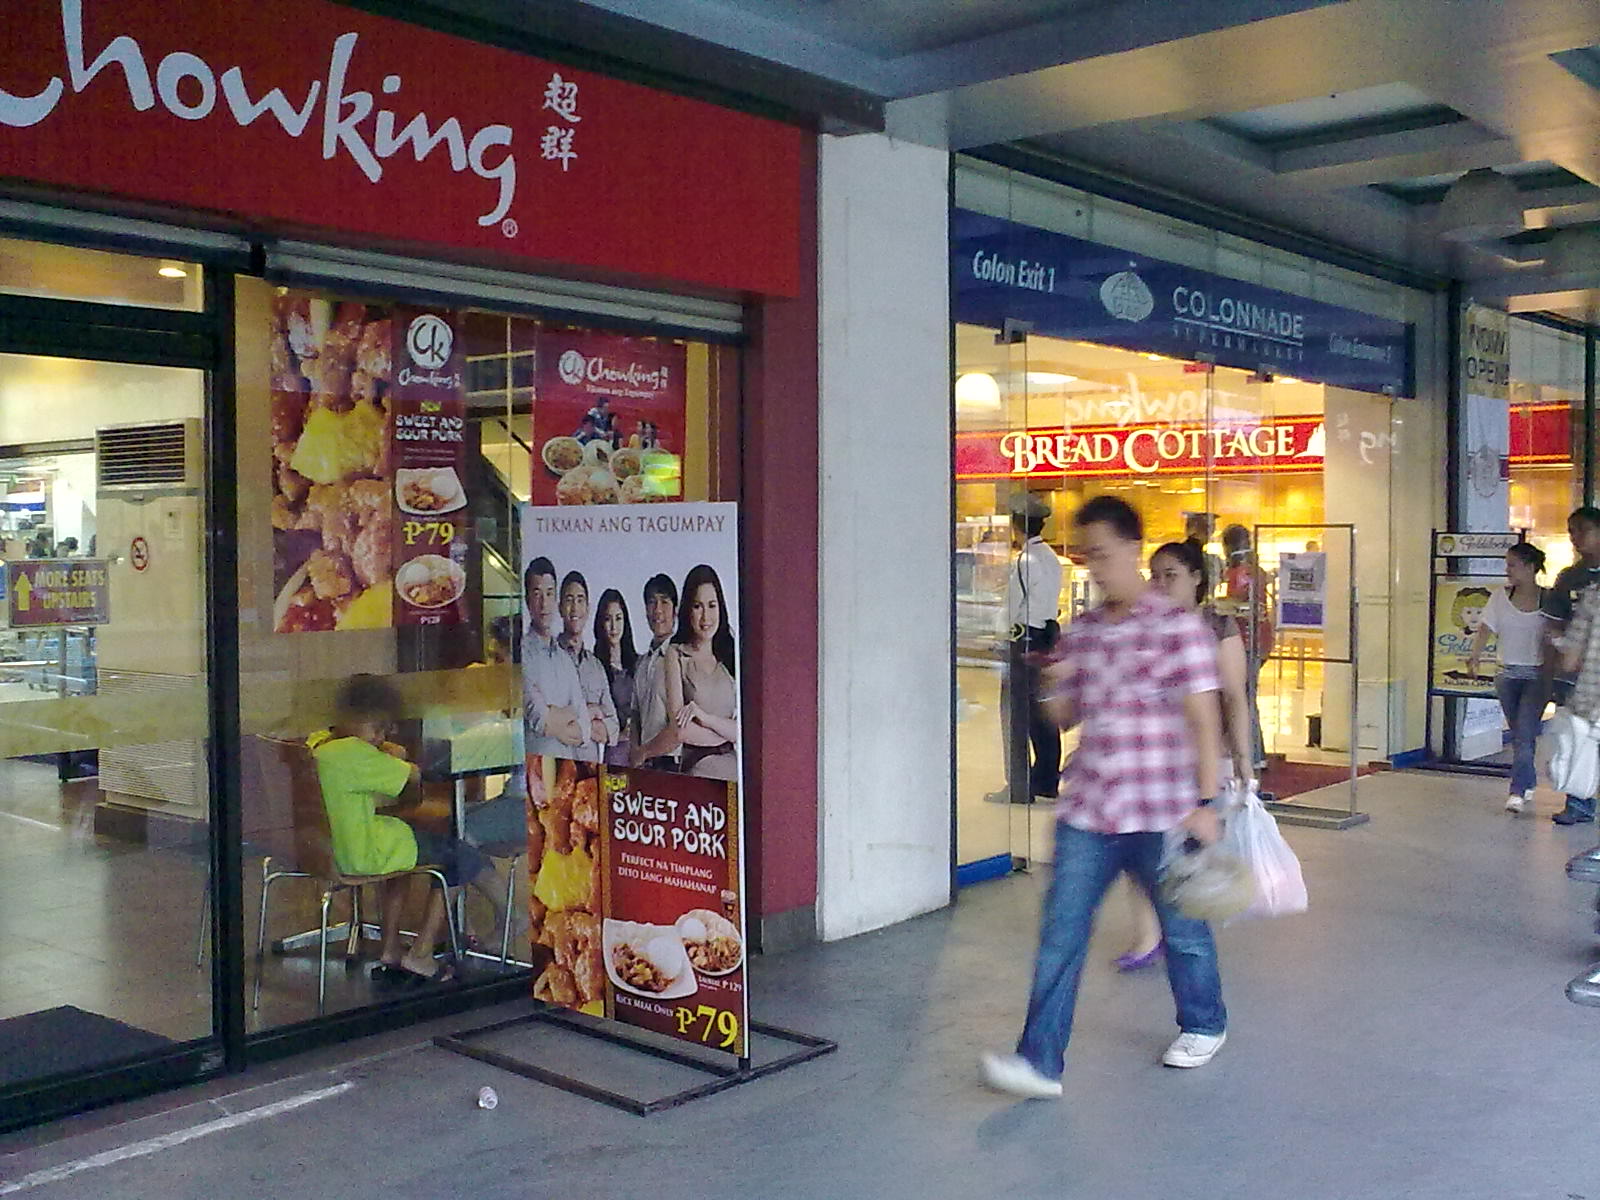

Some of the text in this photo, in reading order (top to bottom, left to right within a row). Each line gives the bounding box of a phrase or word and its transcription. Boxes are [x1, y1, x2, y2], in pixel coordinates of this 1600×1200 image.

[973, 250, 1055, 293] Colon Exit 1
[1173, 286, 1304, 339] COLONNADE
[587, 357, 661, 391] Chowking
[396, 414, 463, 431] SWEET AND
[396, 428, 428, 441] SOUR
[1000, 431, 1118, 473] BREAD
[1124, 426, 1295, 474] COTTAGE
[536, 514, 726, 533] TIKMAN ANG TAGUMPAY
[35, 570, 105, 588] MORE SEATS
[43, 591, 97, 609] UPSTAIRS
[613, 791, 725, 832] SWEET AND
[614, 818, 726, 860] SOUR PORK
[618, 866, 639, 879] DITO
[640, 870, 662, 883] LANG
[621, 852, 713, 879] PERFECT NA TIMPLANG
